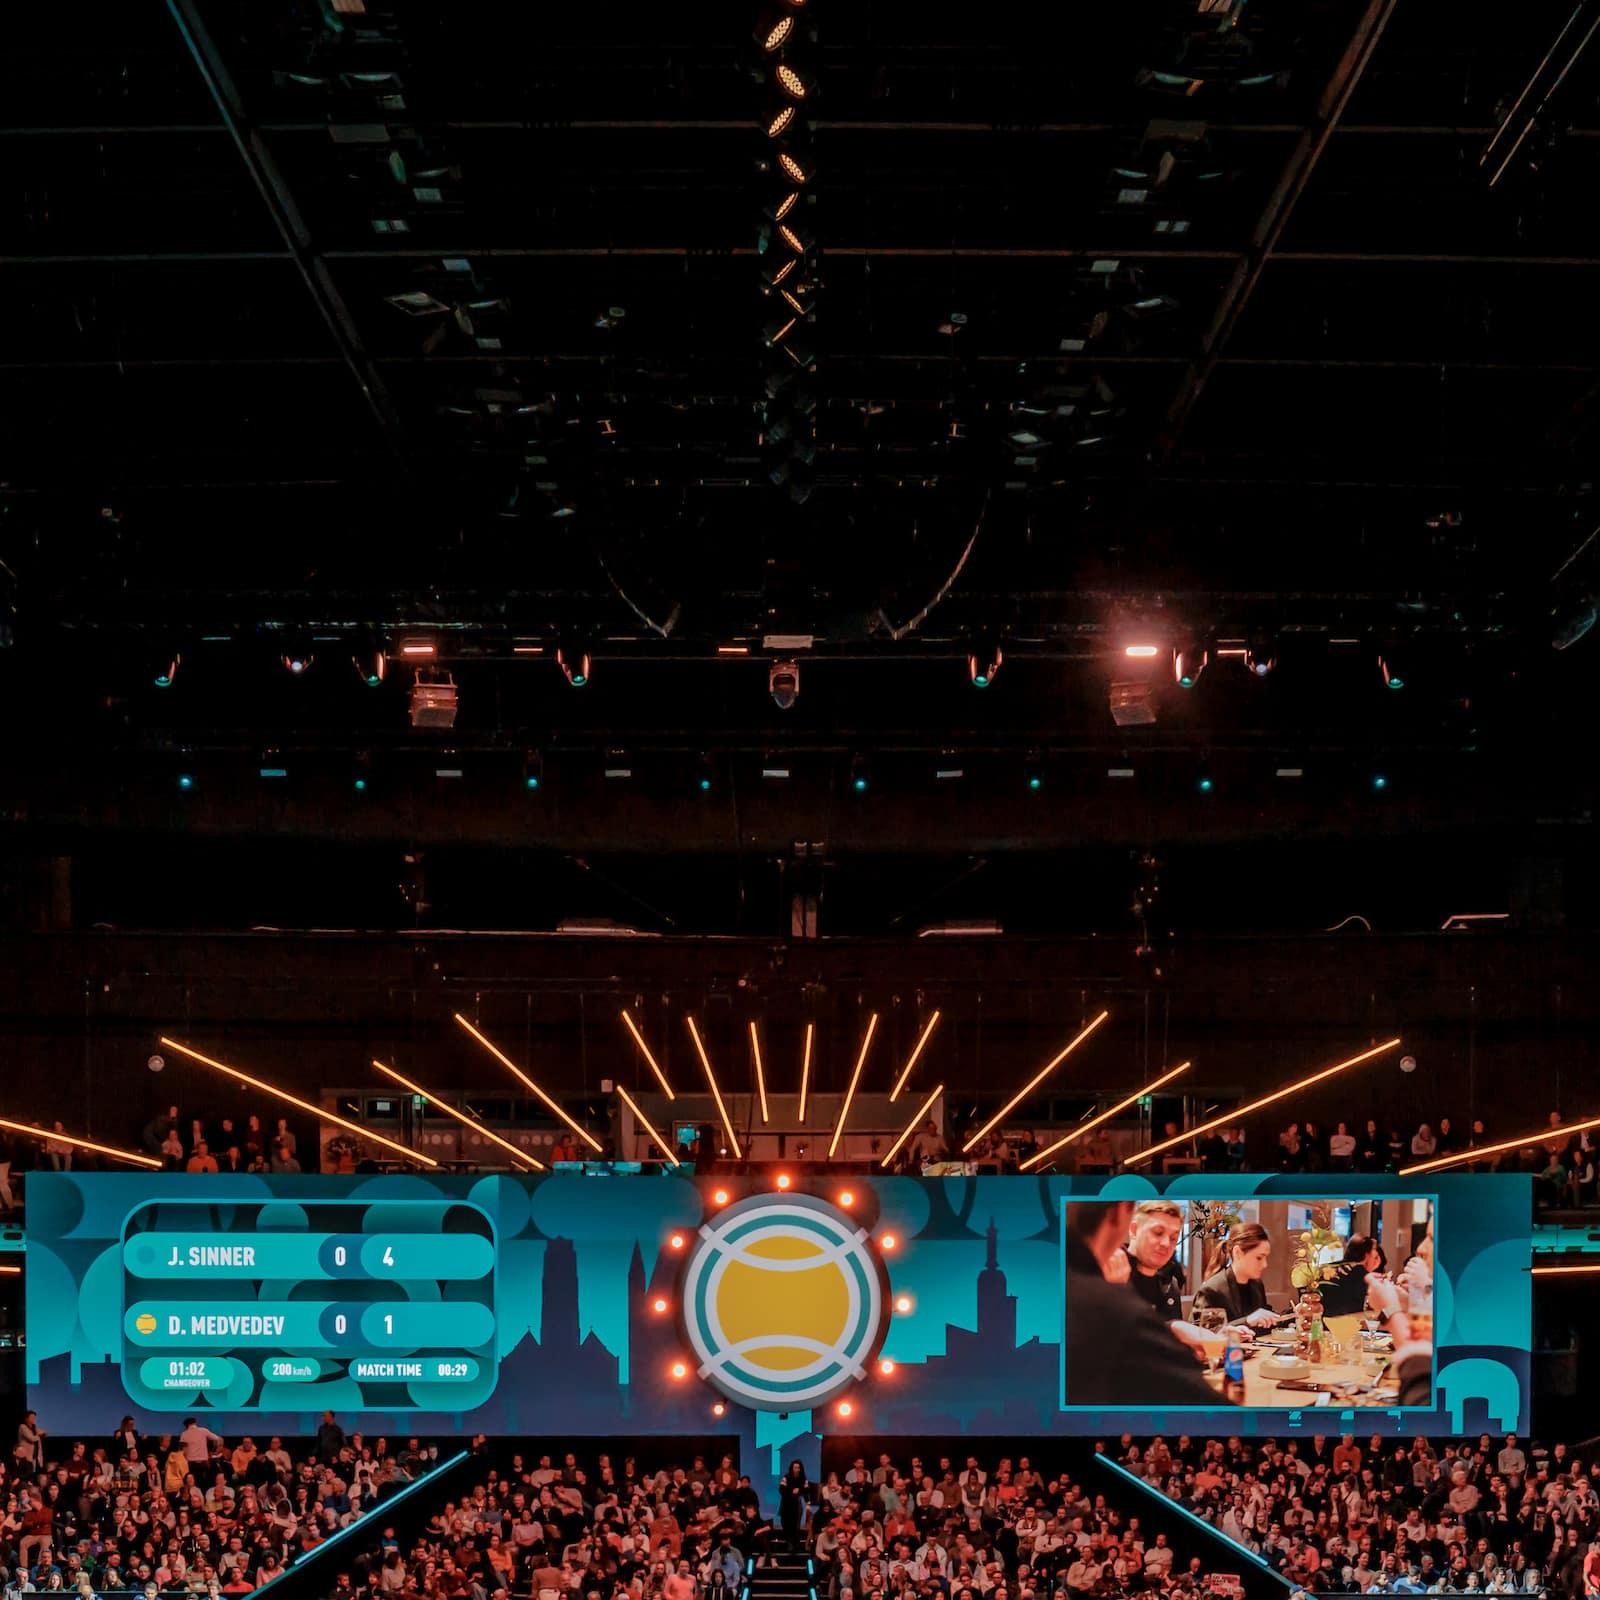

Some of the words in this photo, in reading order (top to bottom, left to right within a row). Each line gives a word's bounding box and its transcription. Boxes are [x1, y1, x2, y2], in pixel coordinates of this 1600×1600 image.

[167, 1246, 184, 1266] J.
[189, 1246, 255, 1266] SINNER
[335, 1246, 346, 1266] 0
[383, 1247, 394, 1266] 4
[168, 1315, 187, 1335] D.
[191, 1315, 285, 1336] MEDVEDEV
[335, 1315, 346, 1334] 0
[384, 1315, 393, 1334] 1
[169, 1361, 205, 1376] 01:02
[272, 1363, 293, 1376] 200
[357, 1363, 395, 1377] MATCH
[395, 1363, 422, 1377] TIME
[438, 1363, 468, 1377] 00:29
[163, 1378, 211, 1388] CHANGEOVER
